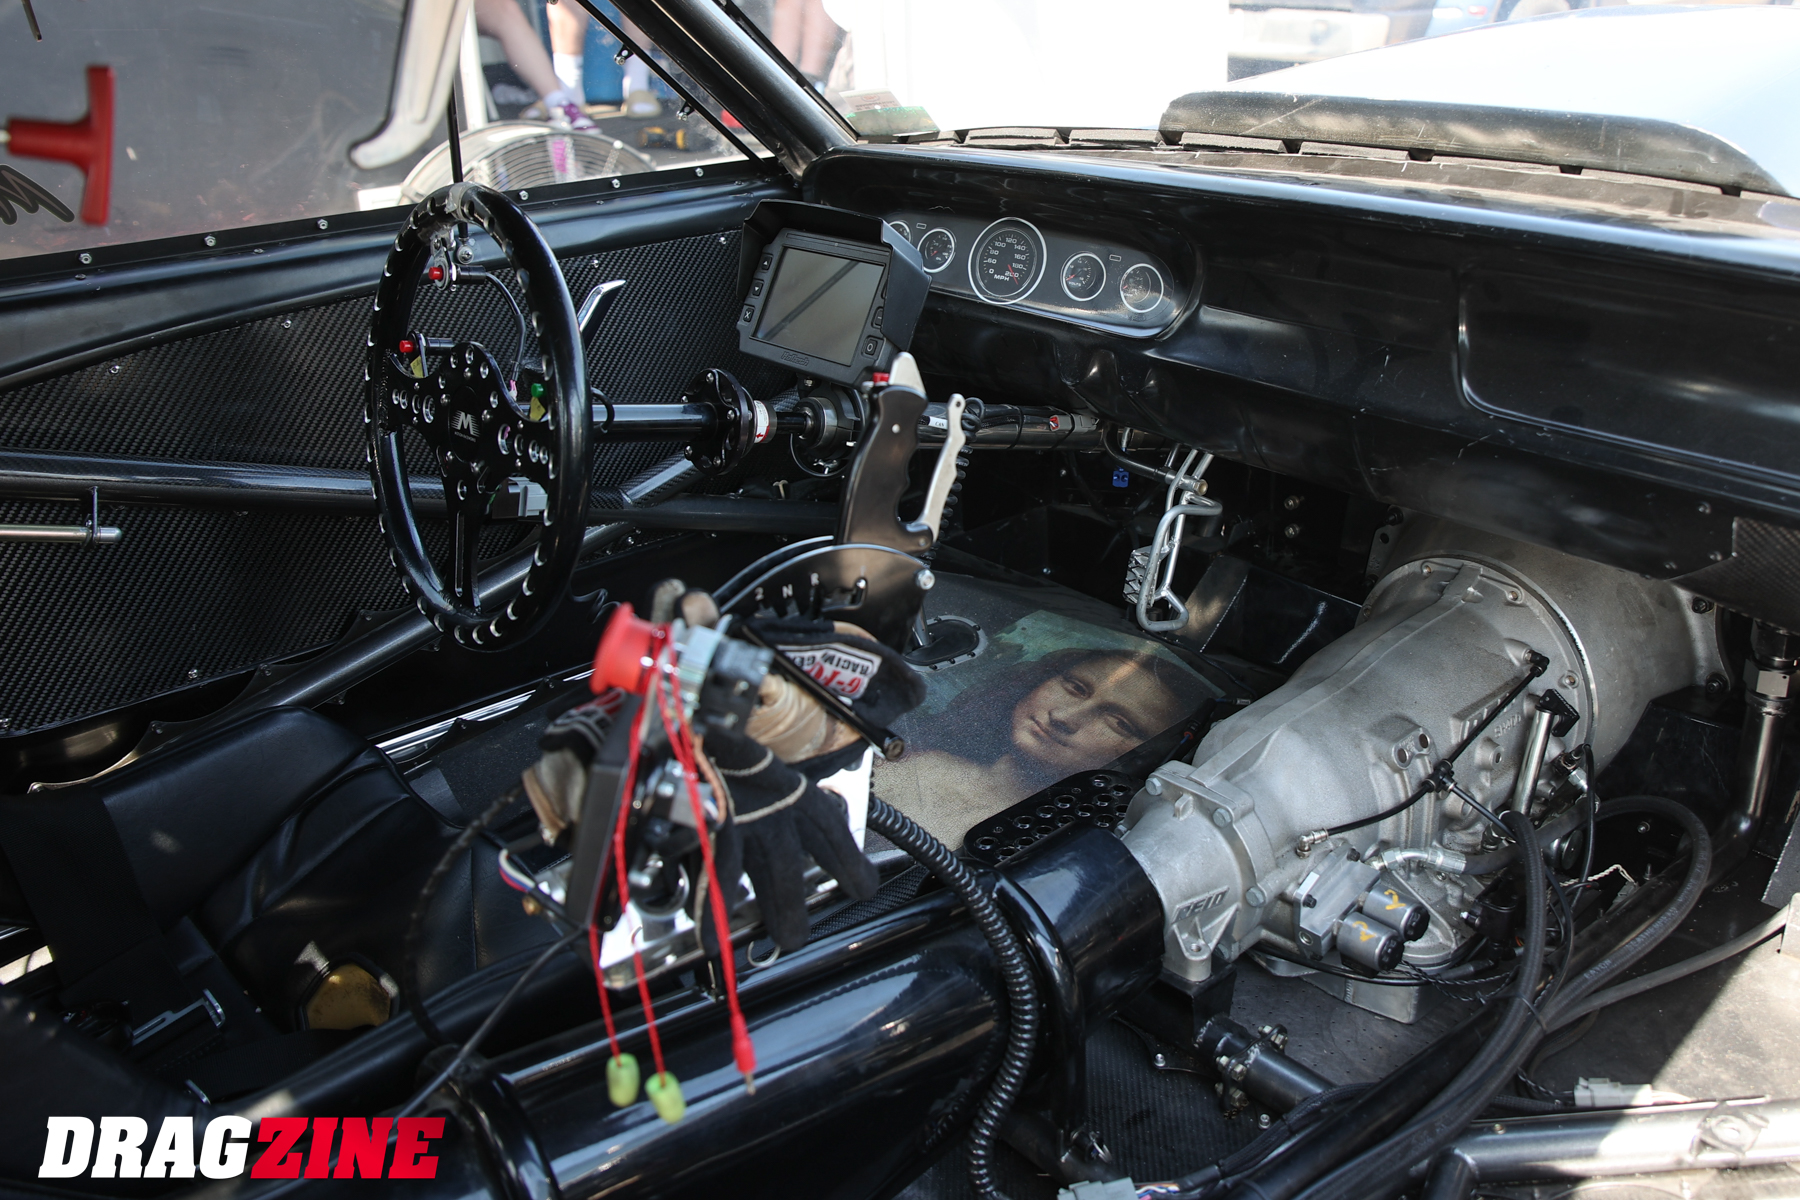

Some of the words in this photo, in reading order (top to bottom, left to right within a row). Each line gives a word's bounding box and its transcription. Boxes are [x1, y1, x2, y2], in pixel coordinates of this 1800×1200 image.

[1014, 253, 1027, 261] 160
[993, 274, 1010, 282] MPH
[1004, 270, 1020, 278] 200
[754, 586, 765, 601] 2
[781, 583, 794, 599] N
[810, 572, 820, 586] R
[804, 661, 862, 694] G-FO
